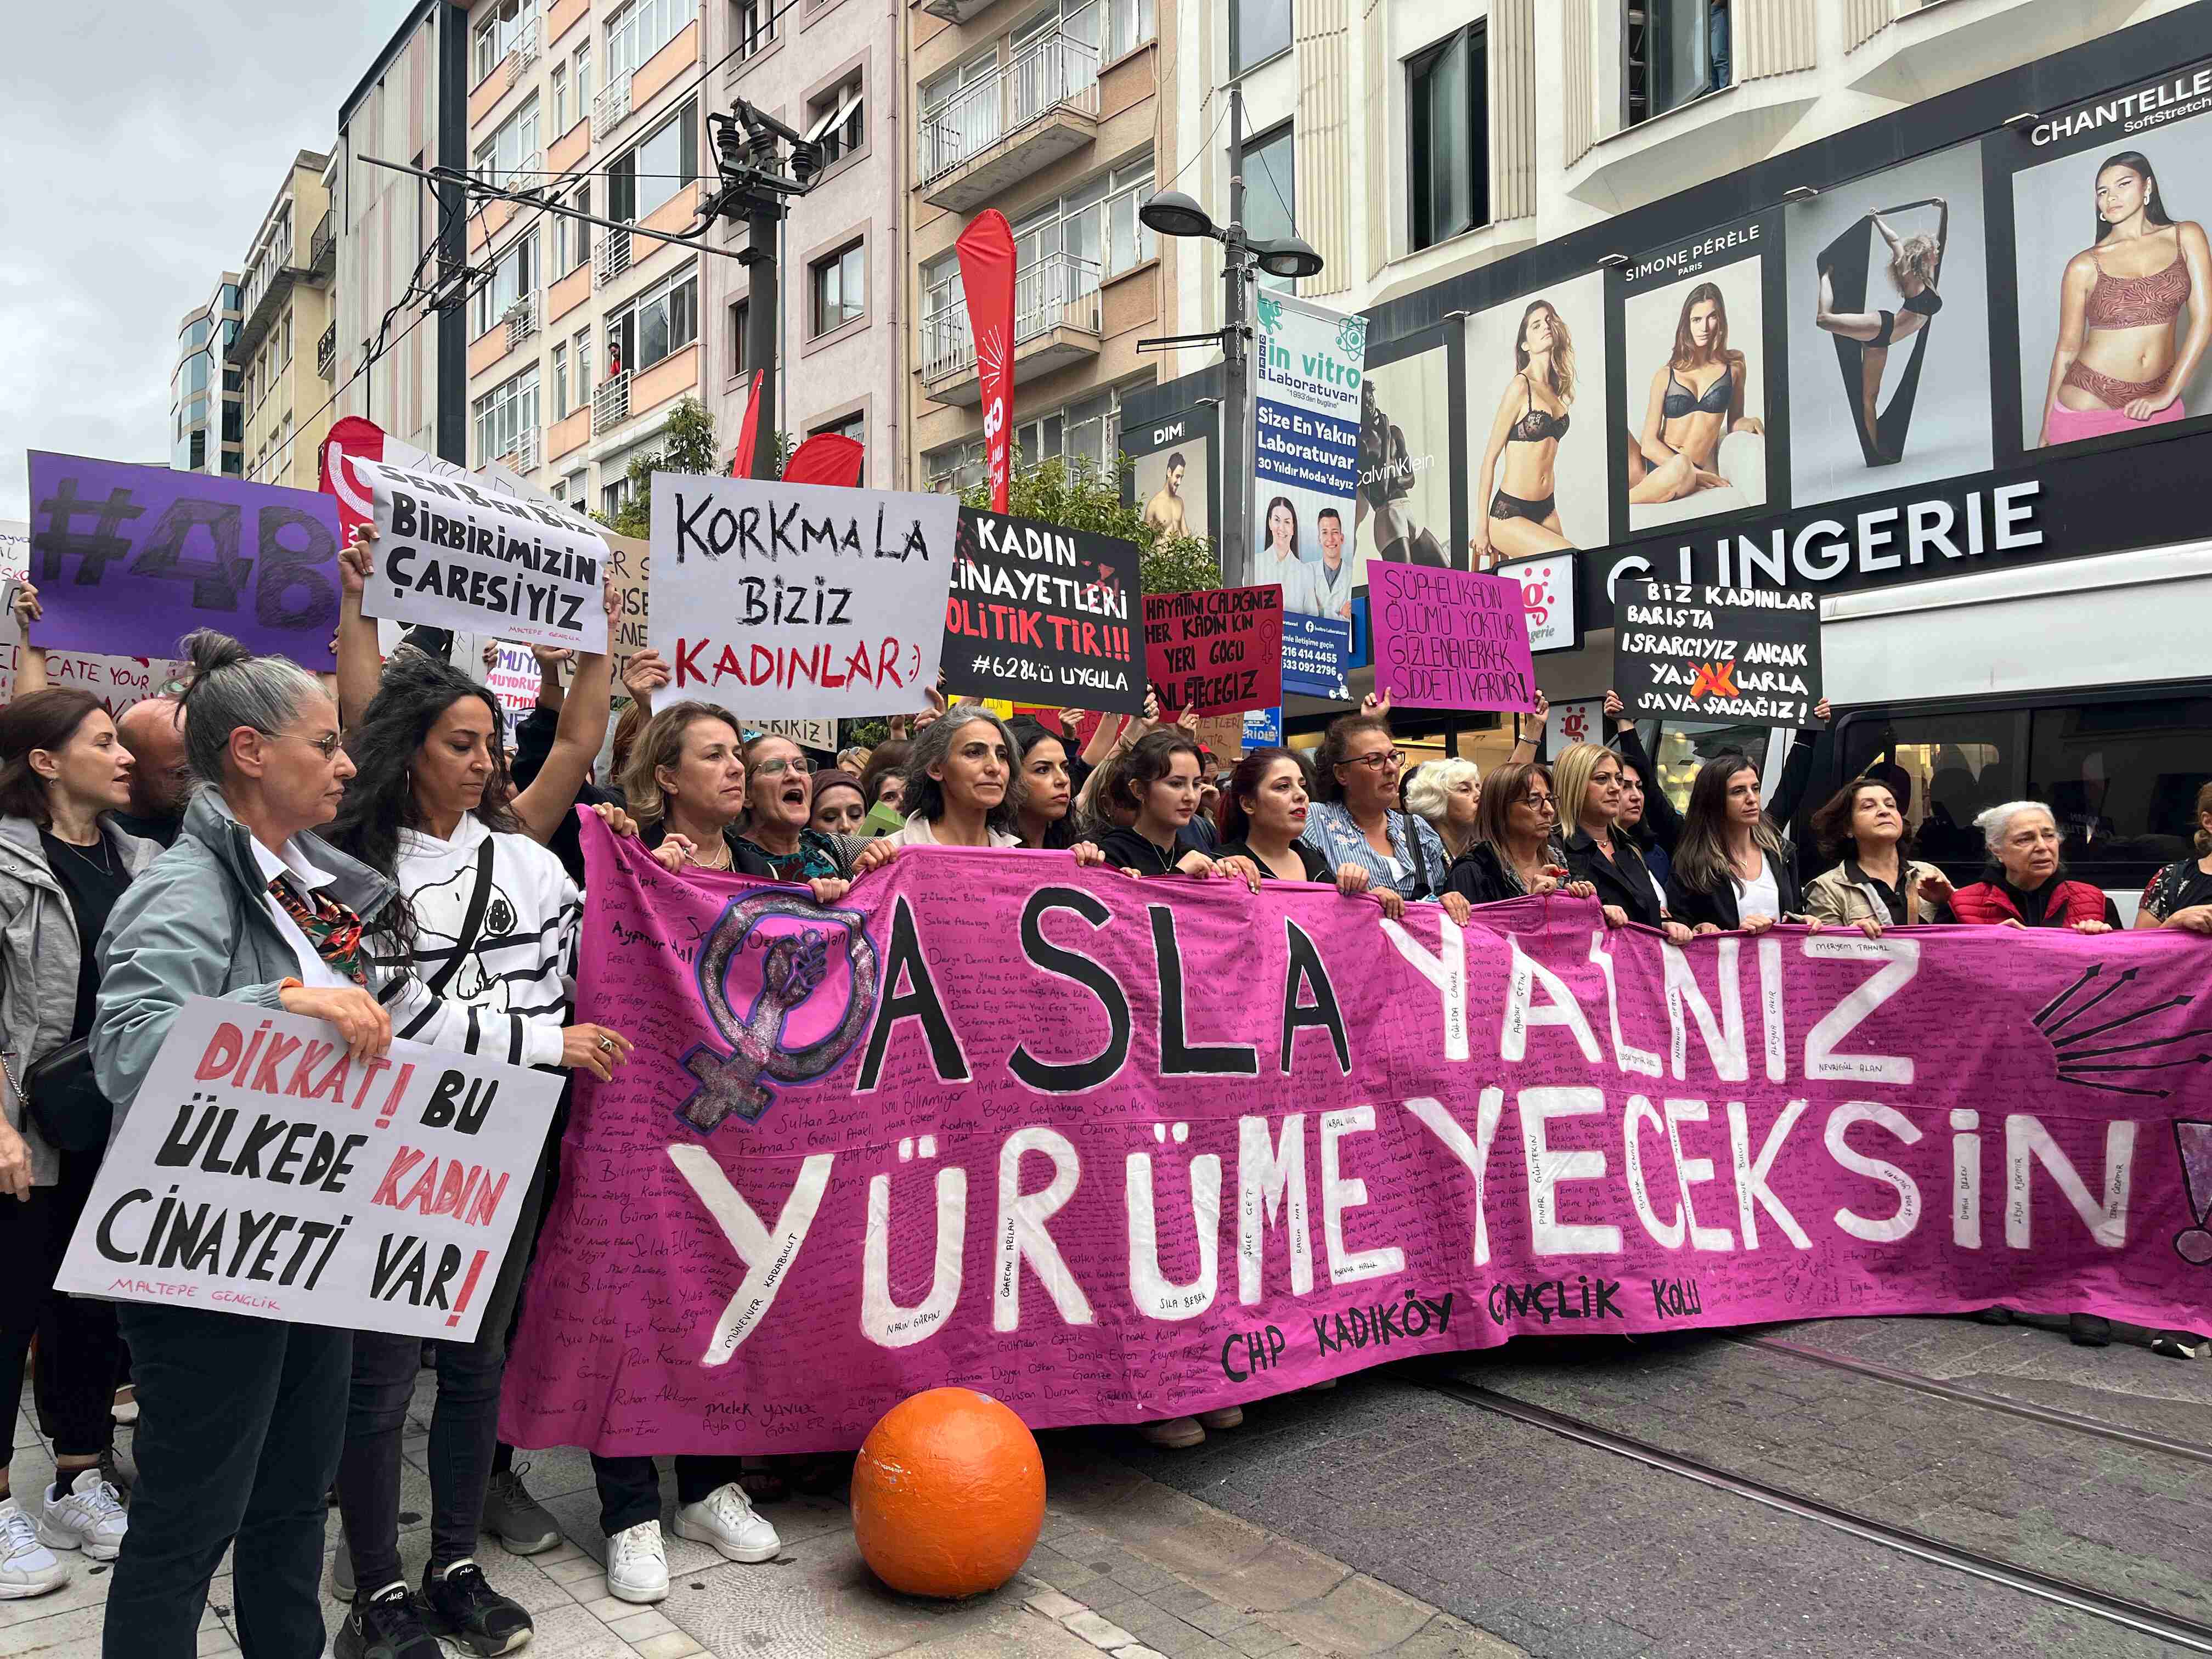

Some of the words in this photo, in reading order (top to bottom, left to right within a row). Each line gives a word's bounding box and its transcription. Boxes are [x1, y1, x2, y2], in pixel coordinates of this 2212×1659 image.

[2031, 70, 2211, 146] CHANTELLE
[2124, 96, 2211, 133] SoftStretch
[1626, 250, 1688, 282] SIMONE
[1693, 224, 1760, 259] PÉRÈLE
[1678, 262, 1703, 276] PARIS
[1268, 337, 1290, 370] in
[1301, 352, 1361, 390] vitro
[1268, 368, 1358, 405] Laboratuvarı
[1154, 422, 1182, 445] DIM
[1257, 406, 1290, 430] Size
[1293, 415, 1312, 436] En
[1314, 420, 1357, 447] Yakın
[1257, 430, 1355, 471] Laboratuvar
[1257, 456, 1272, 470] 30
[1273, 460, 1299, 477] Yıldır
[1397, 453, 1435, 477] Klein
[391, 490, 596, 586] BİRBİRİMİZİN
[977, 517, 1076, 567] KADIN
[386, 546, 585, 631] ÇARESİYİZ
[735, 574, 853, 627] BİZİZ
[1647, 582, 1693, 603] BİZ
[1705, 585, 1816, 611] KADINLAR
[1144, 623, 1172, 644] HER
[1385, 600, 1452, 636] ÖLÜMÜ
[1459, 610, 1518, 642] YOKTUR
[1530, 625, 1555, 644] gerie
[1627, 605, 1714, 630] BARIŞTA
[1282, 634, 1294, 642] imle
[1282, 645, 1297, 657] 216
[1298, 648, 1313, 661] 414
[1314, 649, 1338, 664] 4455
[1622, 632, 1738, 661] ISRARCIYIZ
[1743, 642, 1808, 667] ANCAK
[110, 666, 150, 690] YOUR
[1060, 666, 1128, 692] UYGULA
[1298, 663, 1315, 673] 092
[1316, 663, 1337, 676] 2796
[857, 887, 1352, 1095] ASLA
[1379, 913, 1920, 1084] YALNIZ
[193, 1019, 415, 1129] DİKKAT!
[419, 1069, 499, 1136] BU
[154, 1092, 369, 1194] ÜLKEDE
[370, 1146, 510, 1227] KADIN
[95, 1184, 353, 1291] CİNAYETİ
[369, 1232, 490, 1329] VAR!
[108, 1277, 198, 1300] MALTEPE
[1183, 1292, 1207, 1308] BEBEK
[1221, 1324, 1286, 1383] CHP
[1313, 1290, 1453, 1358] KADIKÖY
